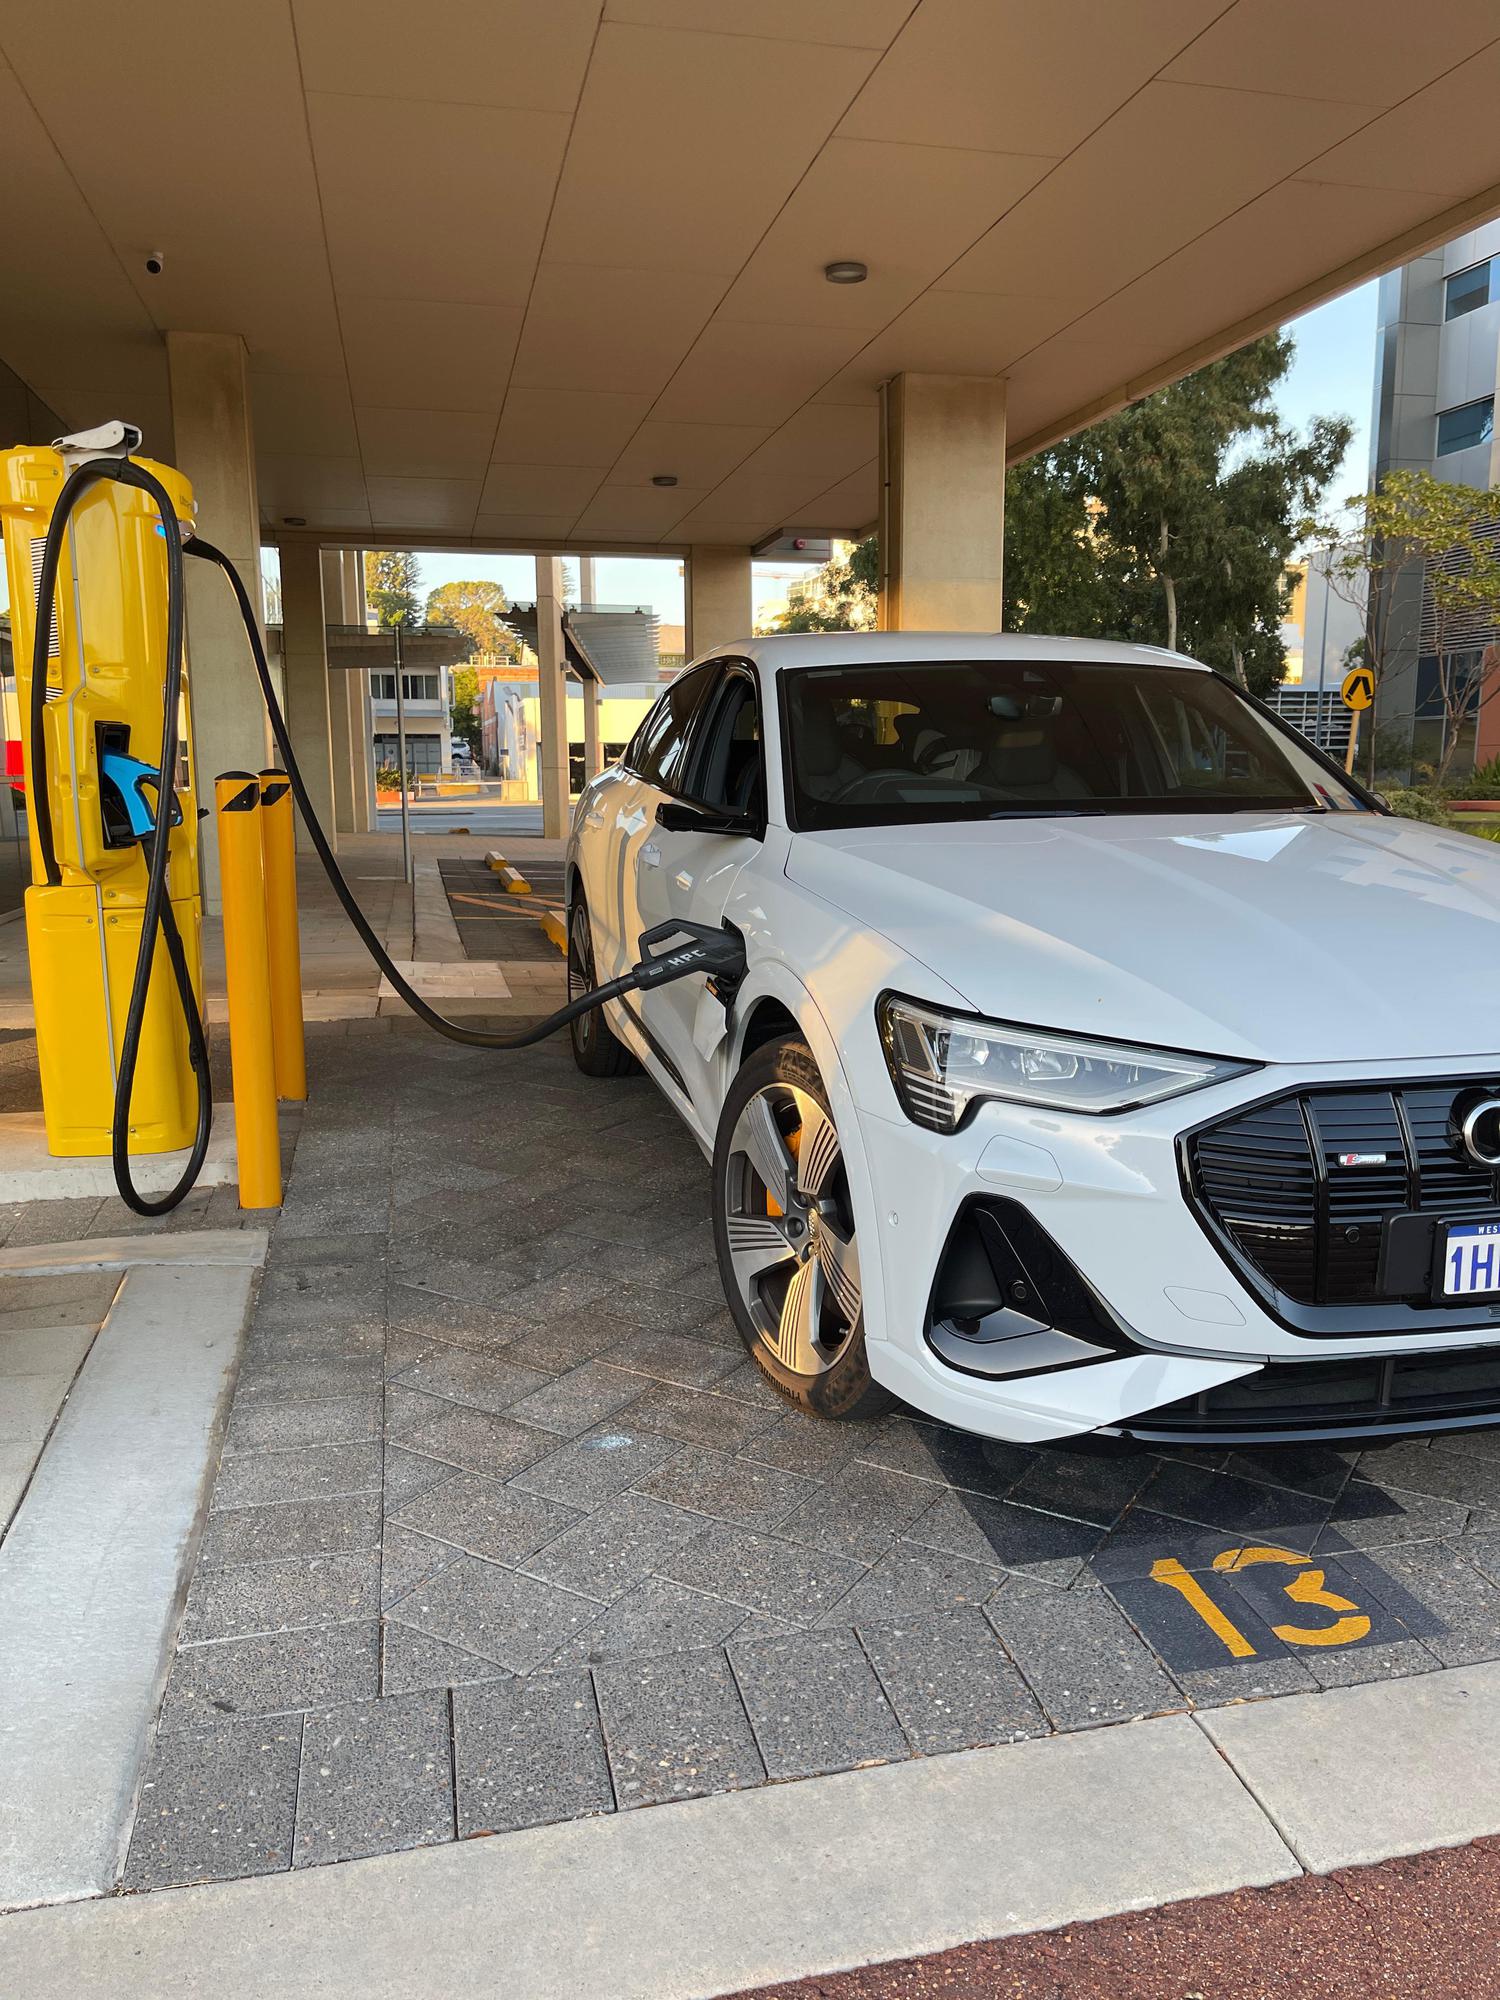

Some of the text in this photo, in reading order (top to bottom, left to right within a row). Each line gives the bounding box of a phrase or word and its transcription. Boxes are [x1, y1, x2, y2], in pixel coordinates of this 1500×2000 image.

[668, 950, 706, 966] HPC
[1478, 1224, 1500, 1235] WES
[1451, 1244, 1500, 1292] 1H
[1150, 1547, 1371, 1657] 13
